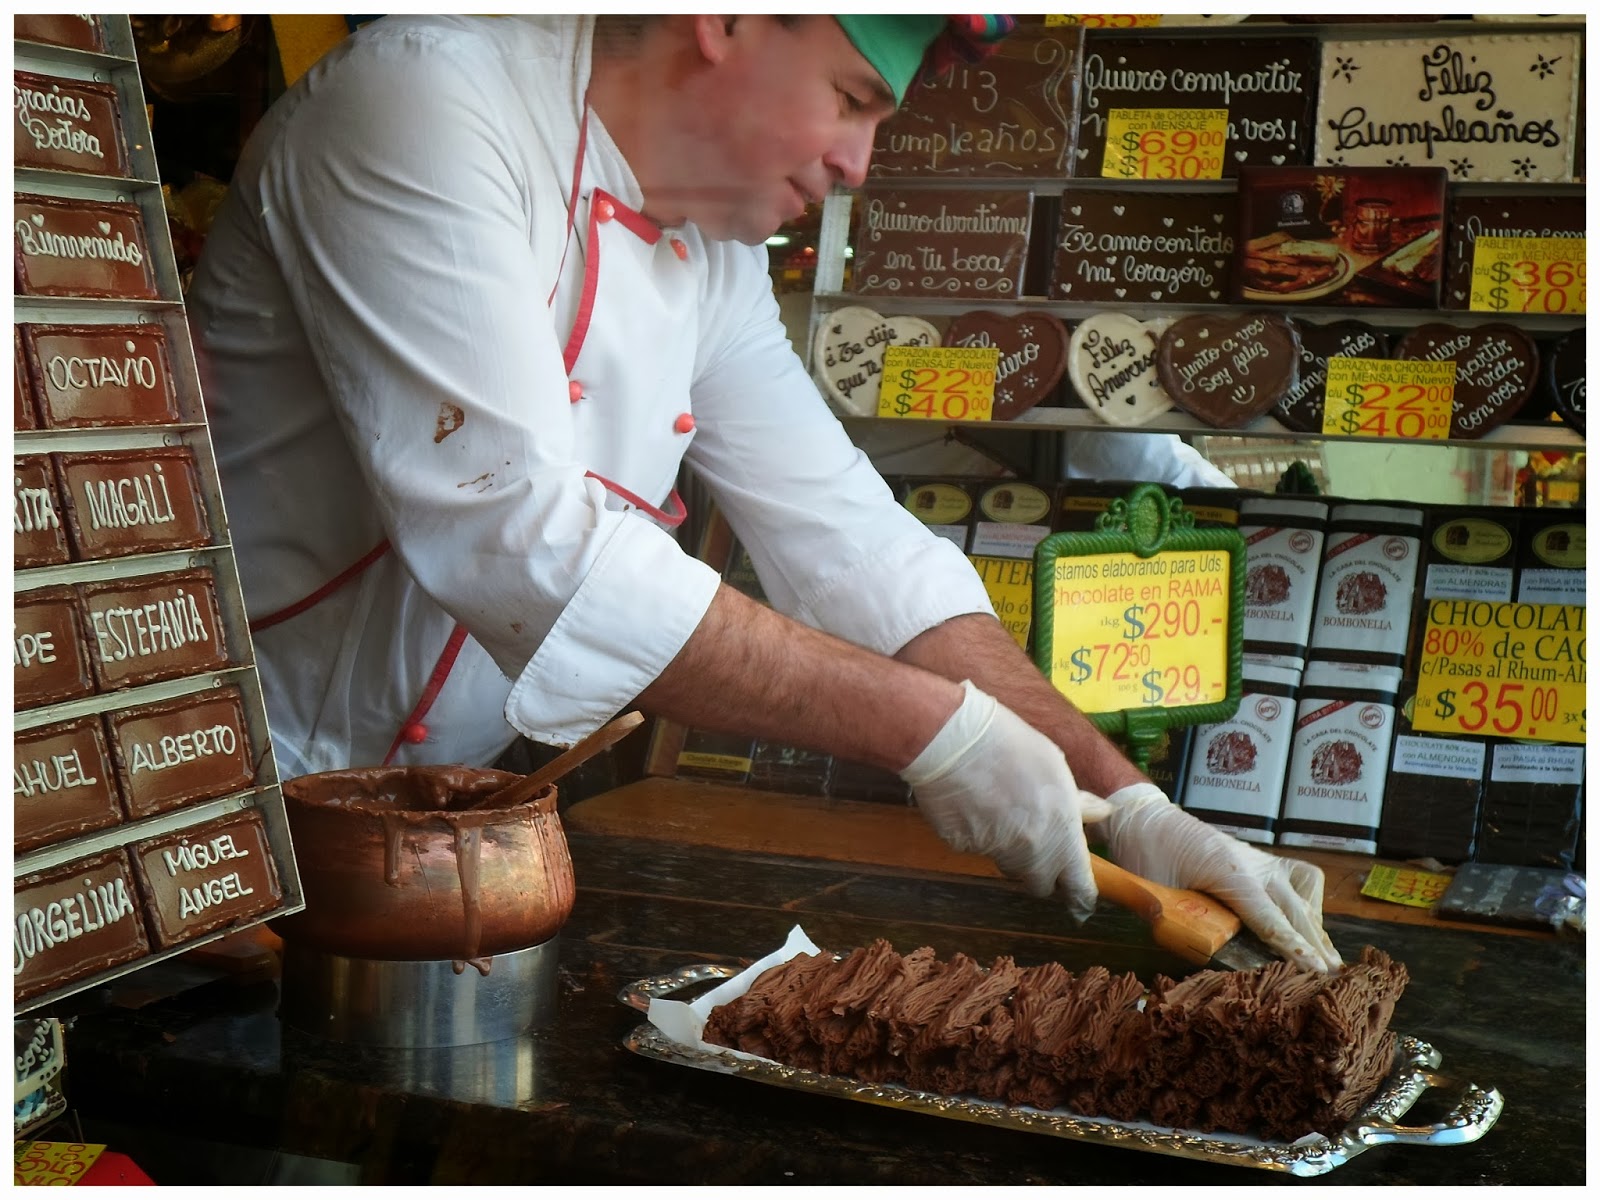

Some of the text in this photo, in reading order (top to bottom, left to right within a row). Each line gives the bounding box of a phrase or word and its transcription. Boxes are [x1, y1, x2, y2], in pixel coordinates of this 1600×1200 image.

[1085, 54, 1302, 108] Quiero compartir
[1419, 44, 1496, 111] Feliz
[1111, 110, 1227, 120] TABLETA de CHOCOLATE
[1128, 120, 1207, 131] con MENSAJE
[1328, 104, 1561, 160] Cumpleaños
[869, 199, 933, 241] Quiero
[15, 219, 143, 266] Bienvenido
[1060, 223, 1234, 254] Te amo con todo
[1477, 238, 1523, 249] TABLETA
[884, 251, 915, 270] en
[917, 247, 946, 271] tu
[1497, 251, 1585, 262] con MENSAJE
[1077, 256, 1117, 283] mi
[932, 350, 942, 358] de
[944, 350, 998, 360] CHOCOLATE
[1082, 329, 1136, 369] Feliz
[886, 359, 903, 367] con
[906, 359, 956, 369] MENSAJE
[1381, 364, 1393, 372] de
[1395, 363, 1455, 374] CHOCOLATE
[1328, 372, 1348, 381] con
[1351, 372, 1408, 384] MENSAJE
[1055, 554, 1224, 581] stamos elaborando para Uds.
[1141, 586, 1161, 601] en
[1168, 577, 1223, 600] RAMA
[1447, 577, 1507, 589] ALMENDRAS
[1322, 616, 1392, 631] BOMBONELLA
[1425, 628, 1485, 658] 80%
[1493, 632, 1525, 659] de
[1421, 656, 1482, 678] c/Pasas
[1486, 659, 1501, 678] al
[131, 724, 236, 776] ALBERTO
[1343, 729, 1378, 752] CHOCOLATE
[1416, 752, 1478, 766] ALMENDRAS
[1513, 754, 1537, 763] PASA
[1192, 775, 1261, 793] BOMBONELLA
[1297, 785, 1368, 802] BOMBONELLA
[179, 872, 254, 920] ANGEL
